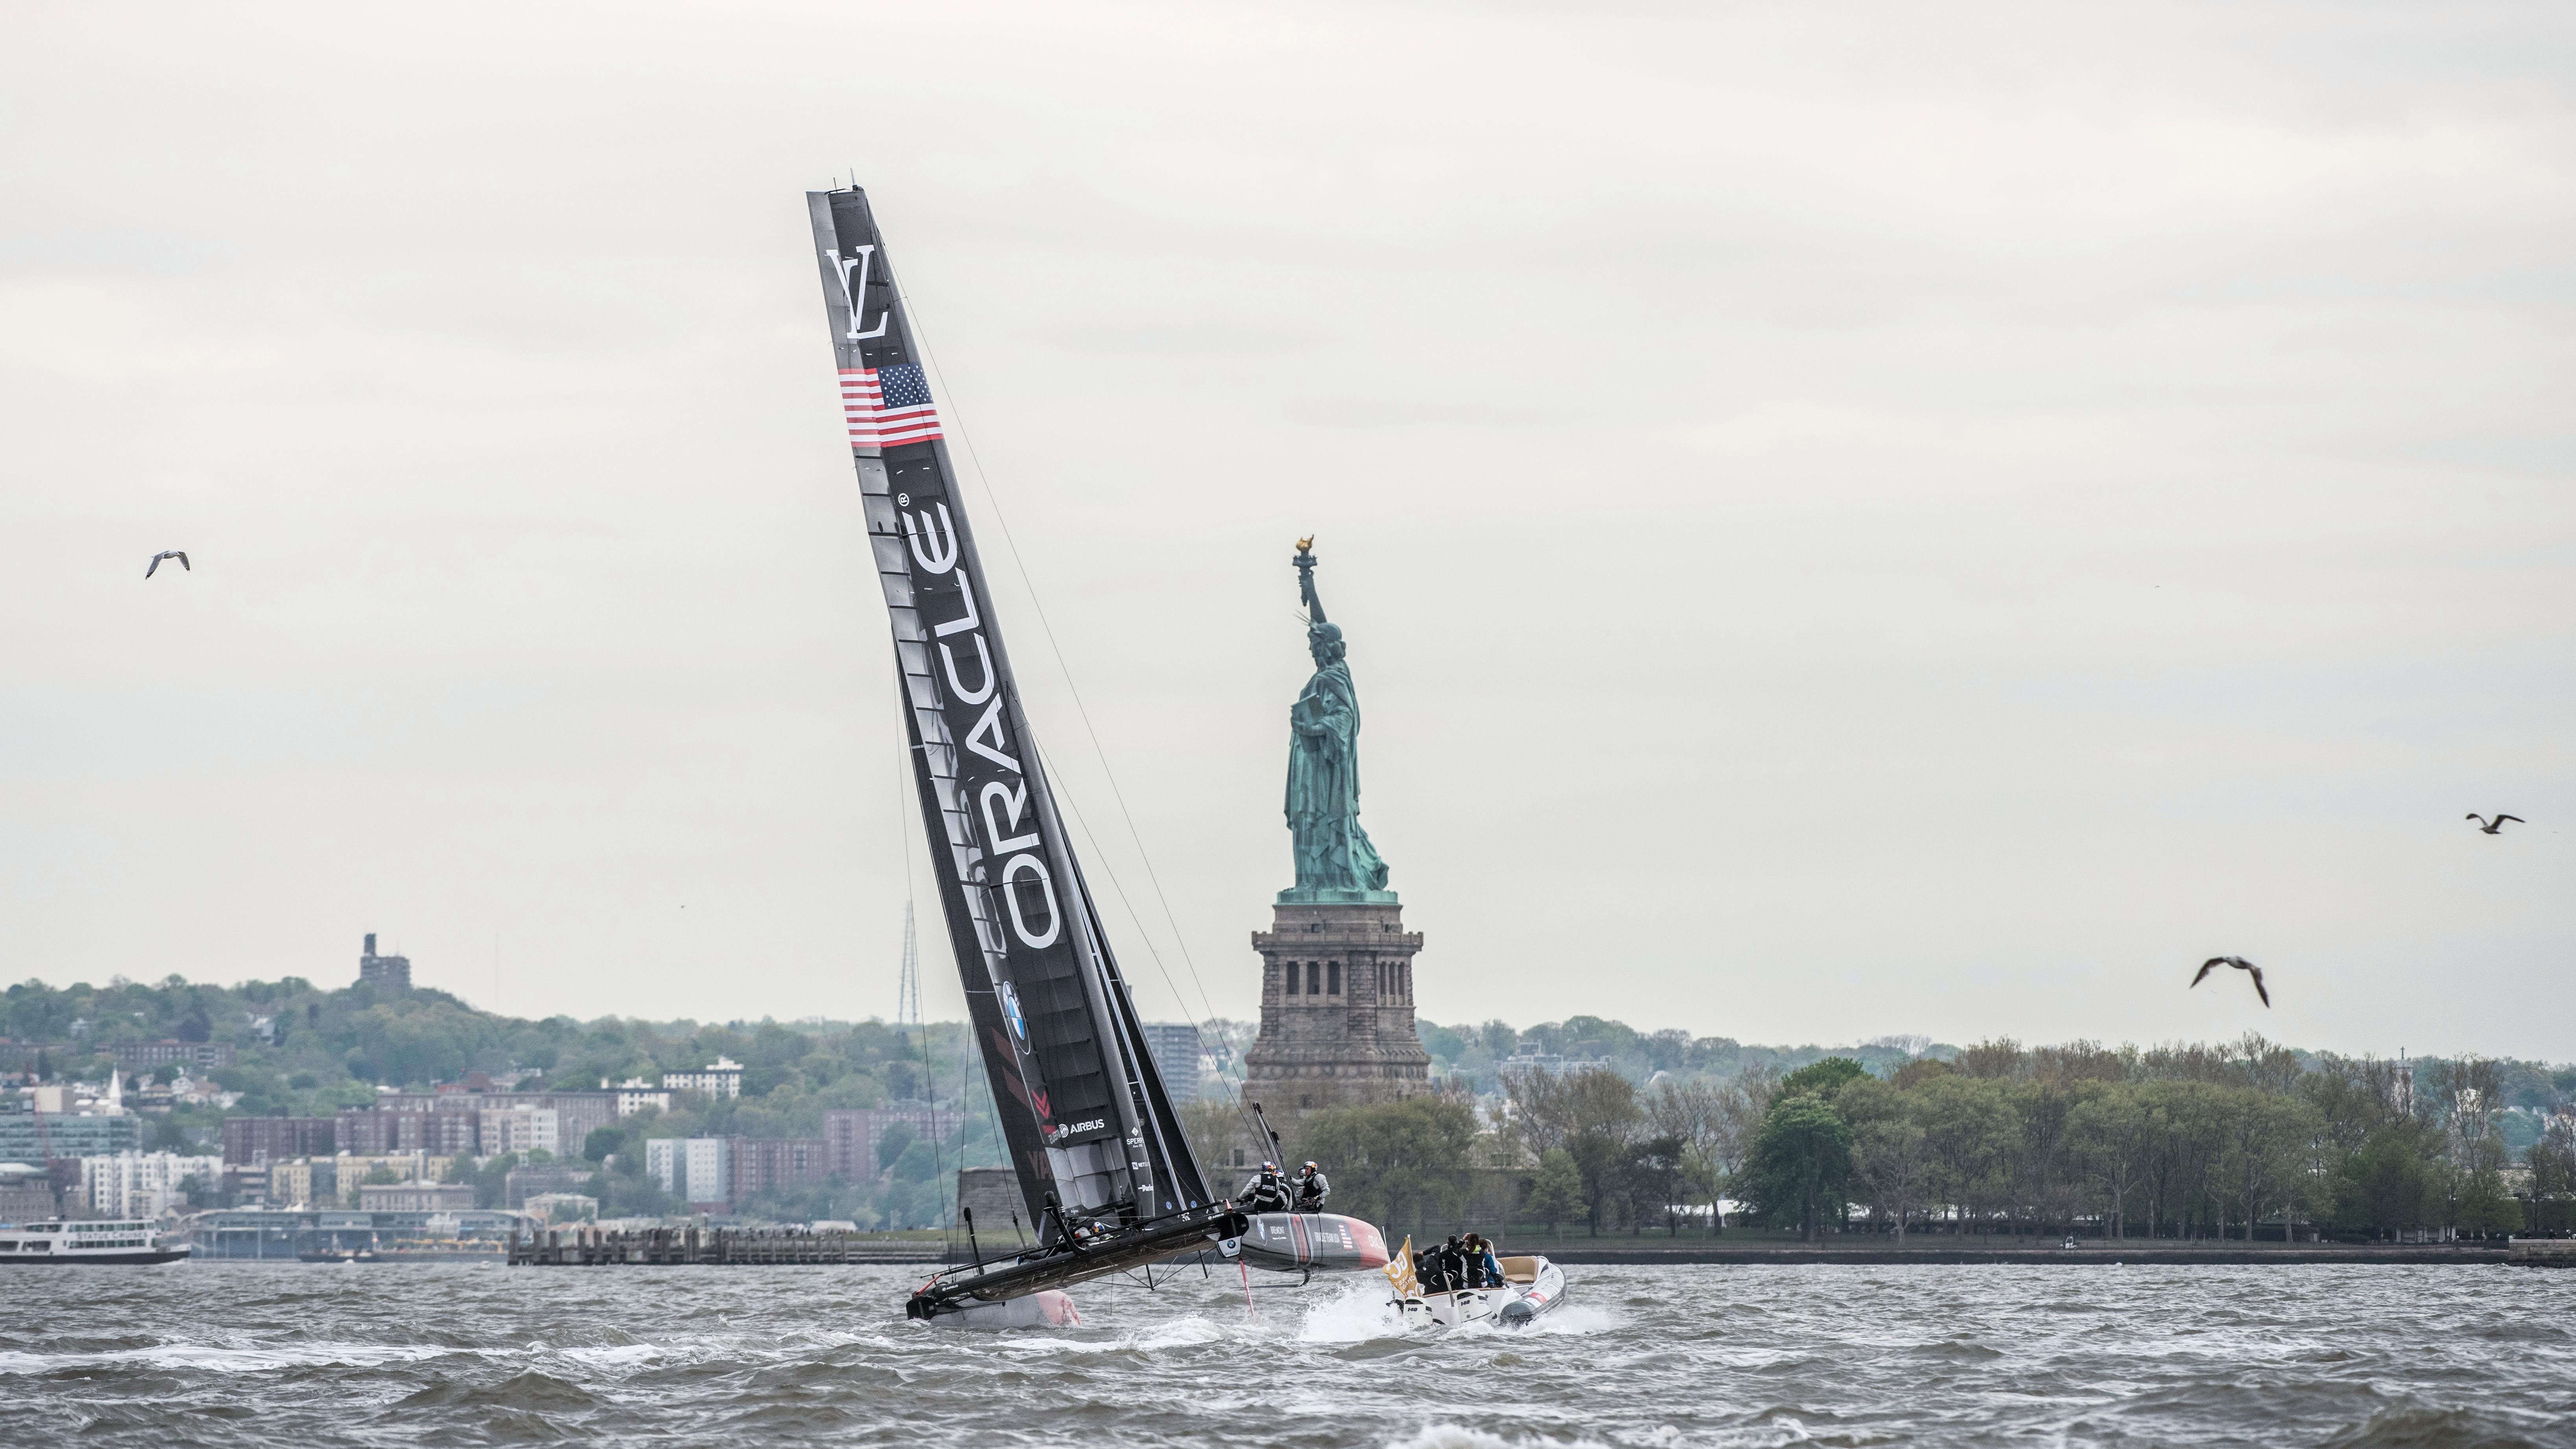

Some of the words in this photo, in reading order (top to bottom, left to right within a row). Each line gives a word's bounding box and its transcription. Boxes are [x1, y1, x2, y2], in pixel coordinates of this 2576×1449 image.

[1070, 1119, 1104, 1134] AIRBUS
[1270, 1226, 1285, 1234] BREMONT
[1325, 1233, 1334, 1242] TEAM
